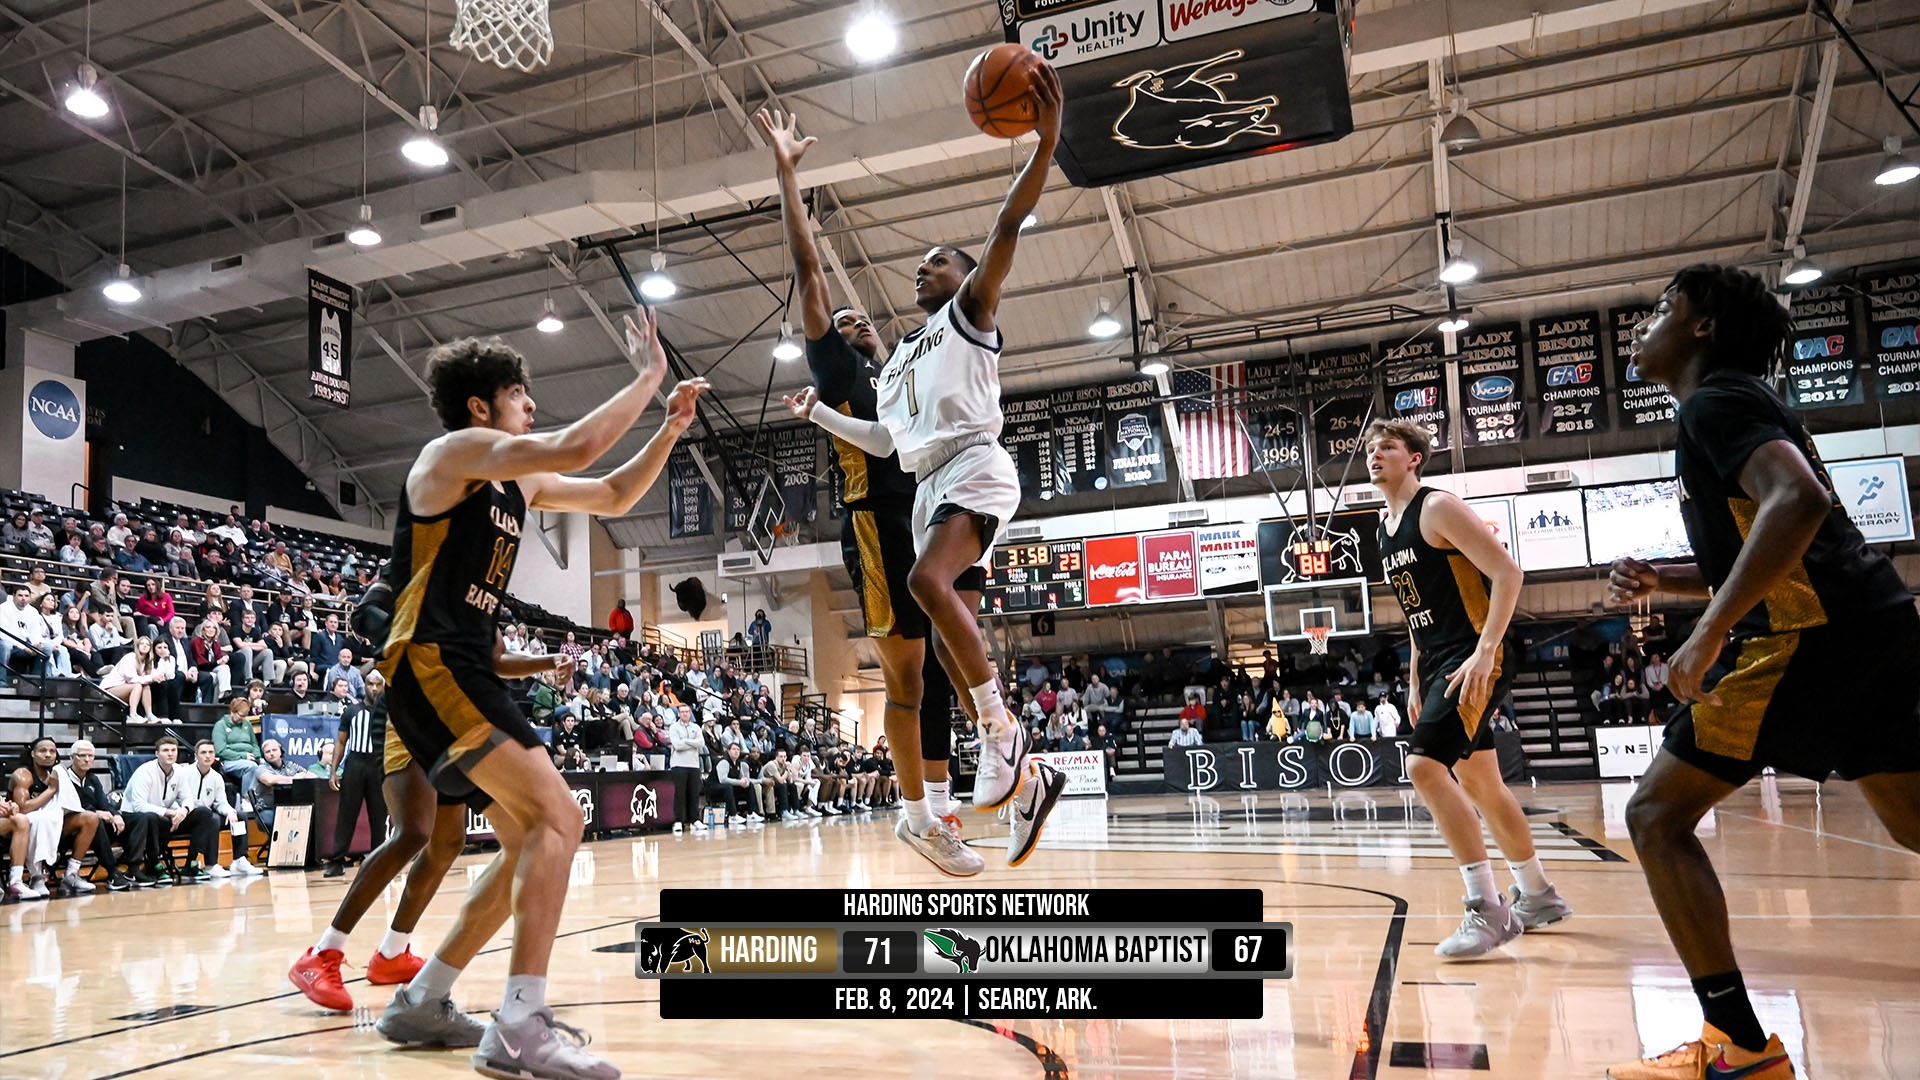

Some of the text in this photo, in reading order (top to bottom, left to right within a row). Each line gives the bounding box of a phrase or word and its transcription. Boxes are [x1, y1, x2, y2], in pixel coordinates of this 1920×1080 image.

[1071, 10, 1145, 43] Unity
[1077, 36, 1124, 54] HEALTH
[1871, 290, 1920, 308] BISO
[1538, 319, 1590, 337] LADY
[1463, 331, 1513, 348] LADY
[1538, 335, 1594, 352] BISON
[322, 341, 339, 360] 45
[1386, 342, 1434, 360] LADY
[1793, 335, 1844, 360] GAC
[1312, 356, 1339, 370] LADY
[1341, 351, 1371, 366] BISON
[1538, 350, 1597, 366] BASKETBALL
[1247, 366, 1272, 380] LADY
[1463, 360, 1519, 375] BASKETBALL
[1546, 363, 1593, 386] GAC
[1789, 360, 1853, 375] CHAMPIONS
[1107, 380, 1154, 398] BISON
[1798, 375, 1848, 389] 31-4
[905, 368, 918, 417] 1
[1051, 387, 1103, 405] LADY BISON
[1477, 385, 1513, 396] NCAA
[1543, 386, 1600, 402] CHAMPIONS
[1799, 389, 1849, 403] 2017
[1002, 398, 1050, 414] LADY BISON
[1394, 386, 1438, 411] GAC
[31, 396, 78, 423] NCAA
[1053, 400, 1103, 414] VOLLEYBALL
[1467, 402, 1521, 416] TOURNAMENT
[1553, 402, 1592, 417] 23-7
[1064, 415, 1091, 426] NCAA
[1329, 415, 1361, 431] 26-4
[1635, 407, 1676, 424] 2015
[1054, 422, 1104, 437] TOURNAMENT
[1264, 421, 1295, 438] 24-5
[1556, 419, 1594, 432] 2015
[1004, 431, 1051, 444] CHAMPIONS
[1478, 428, 1515, 441] 2014
[1112, 453, 1161, 470] FINAL FOUR
[1262, 445, 1300, 466] 1996
[783, 473, 810, 487] 2003
[683, 514, 699, 524] 1993
[1849, 511, 1900, 520] HYSICAL
[1855, 518, 1901, 527] HERAPY
[684, 524, 699, 533] 1994
[1200, 530, 1240, 541] MARK
[1052, 542, 1081, 554] VISITOR
[1200, 540, 1255, 552] MARTIN
[486, 536, 515, 590] 14
[1008, 546, 1049, 566] 3:58
[1059, 552, 1081, 572] 23
[1159, 550, 1191, 562] FARM
[1089, 561, 1138, 581] Coca-Cola
[1148, 560, 1192, 574] BUREAU
[1008, 573, 1028, 581] PERIOD
[1052, 572, 1070, 580] BONUS
[1156, 572, 1193, 582] INSURANCE
[1006, 583, 1047, 594] PLAYER FOULS
[1064, 581, 1082, 589] FOULS
[1048, 592, 1057, 603] 4
[1072, 587, 1082, 601] 5
[1037, 615, 1049, 633] 6
[1599, 744, 1648, 755] DYNE
[1053, 755, 1099, 766] RE/MAX
